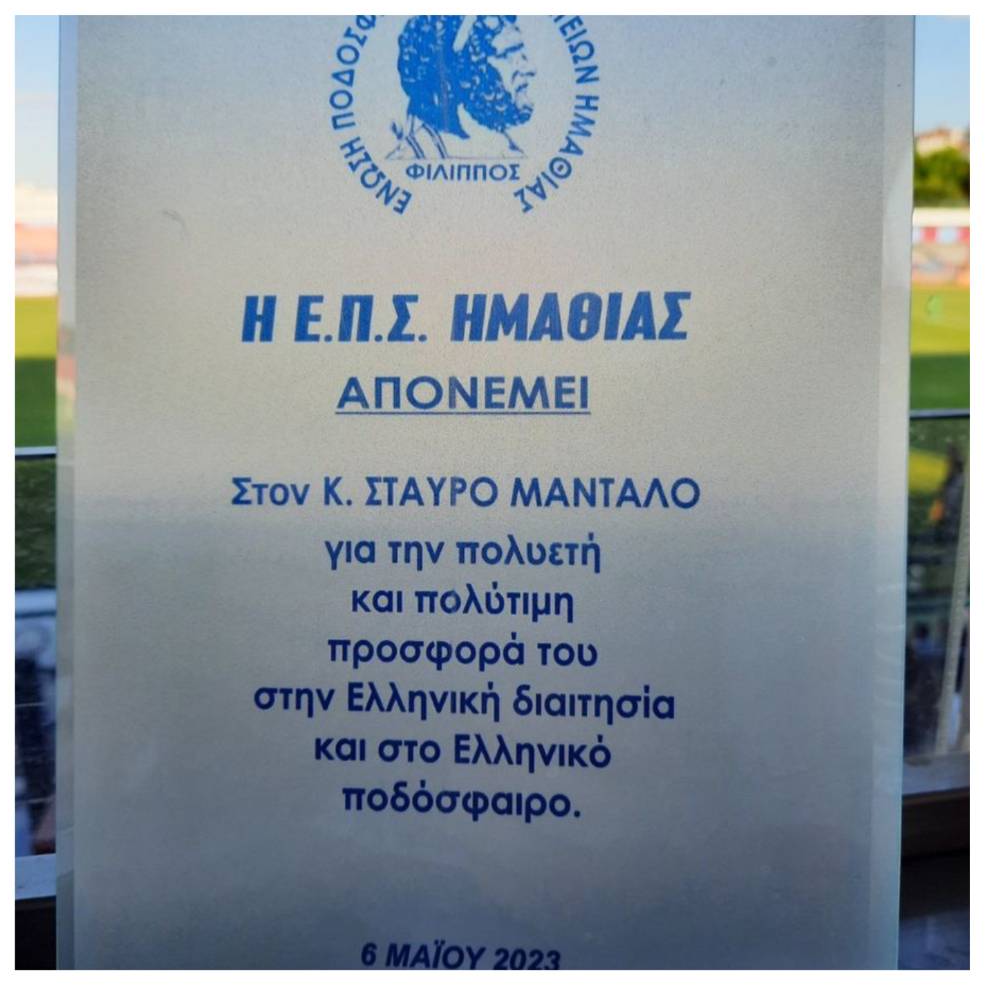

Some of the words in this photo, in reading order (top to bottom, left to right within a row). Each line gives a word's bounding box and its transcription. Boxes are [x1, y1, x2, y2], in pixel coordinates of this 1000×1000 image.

[329, 15, 385, 131] ΠΟΔΟΣΦ
[406, 163, 520, 182] ΦΙΛΙΠΠΟΣ
[513, 94, 599, 214] ΗΜΑΘΙΑΣ
[340, 136, 412, 215] ΕΝΩΣΗ
[241, 294, 277, 343] Η
[294, 294, 428, 343] Ε.Π.Σ.
[450, 291, 692, 342] ΗΜΑΘΙΑΣ
[337, 375, 590, 410] ΑΠΟΝΕΜΕΙ
[231, 476, 310, 506] Στον
[323, 476, 352, 507] Κ.
[365, 475, 499, 508] ΣΤΑΥΡΟ
[510, 476, 701, 509] ΜΑΝΤΑΛΟ
[325, 539, 376, 571] για
[388, 539, 445, 572] την
[457, 533, 601, 574] πολυετή
[351, 588, 403, 614] και
[415, 582, 574, 623] πολύτιμη
[328, 633, 525, 671] προσφορά
[537, 641, 598, 667] του
[254, 685, 335, 718] στην
[348, 681, 500, 722] Ελληνική
[513, 684, 675, 725] διαιτησία
[314, 736, 366, 761] και
[378, 738, 441, 764] στο
[454, 734, 612, 774] Ελληνικό
[342, 780, 582, 824] ποδόσφαιρο.
[361, 942, 378, 967] 6
[385, 939, 487, 970] ΜΑΪΟΥ
[493, 948, 561, 970] 2023
